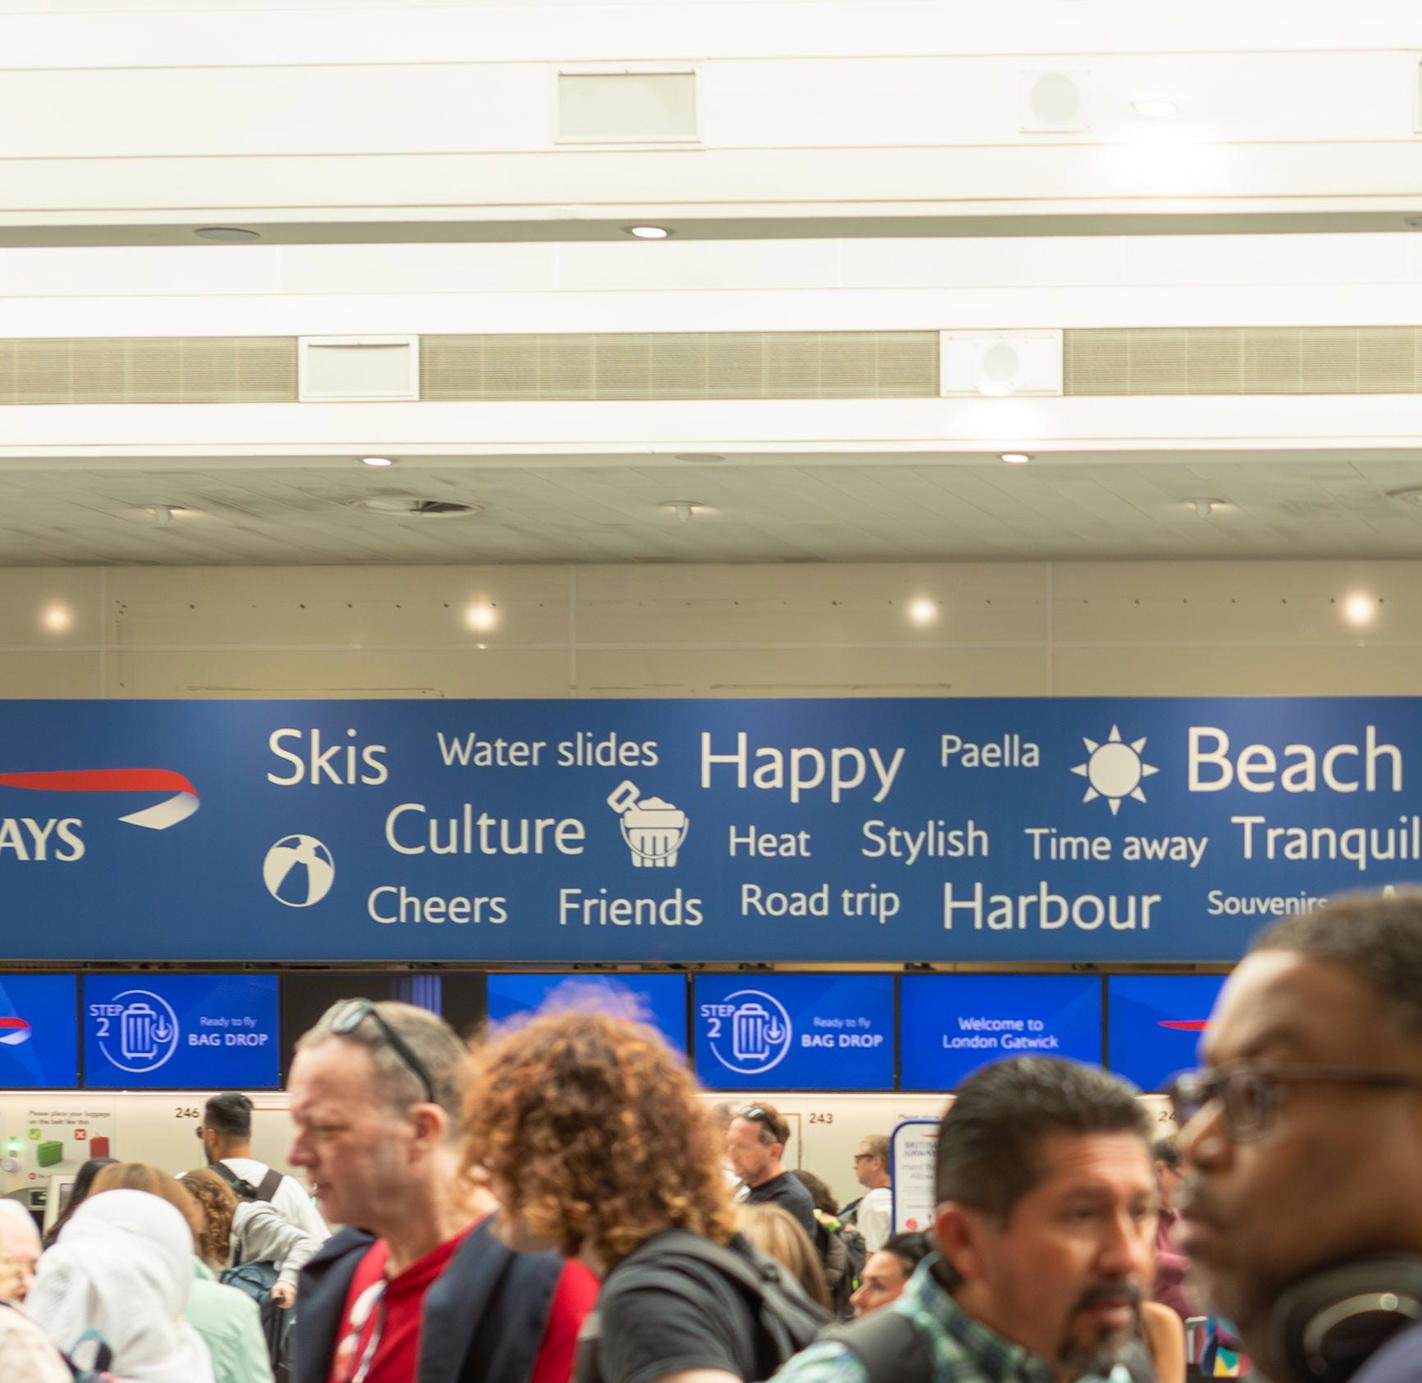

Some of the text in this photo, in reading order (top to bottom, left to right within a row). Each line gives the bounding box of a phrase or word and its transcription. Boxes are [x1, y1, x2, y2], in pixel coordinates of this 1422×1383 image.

[266, 727, 388, 786] Skis
[436, 731, 660, 767] Water slides
[941, 734, 1040, 768] Paella
[1188, 725, 1403, 794] Beach
[701, 731, 905, 804] Happy
[385, 803, 585, 855] Culture
[729, 825, 811, 857] Heat
[861, 819, 989, 866] Stylish
[1024, 827, 1209, 869] Time away
[367, 885, 508, 924] Cheers
[559, 887, 703, 926] Friends
[741, 883, 901, 925] Road trip
[944, 880, 1162, 930] Harbour
[89, 1004, 122, 1017] STEP
[95, 1018, 110, 1037] 2
[700, 1004, 735, 1017] STEP
[957, 1017, 1044, 1032] Welcome to
[188, 1032, 269, 1047] BAG DROP
[707, 1018, 722, 1038] 2
[801, 1033, 884, 1048] BAG DROP
[942, 1033, 1059, 1050] London Gatwick
[175, 1107, 200, 1119] 246
[808, 1112, 834, 1125] 243
